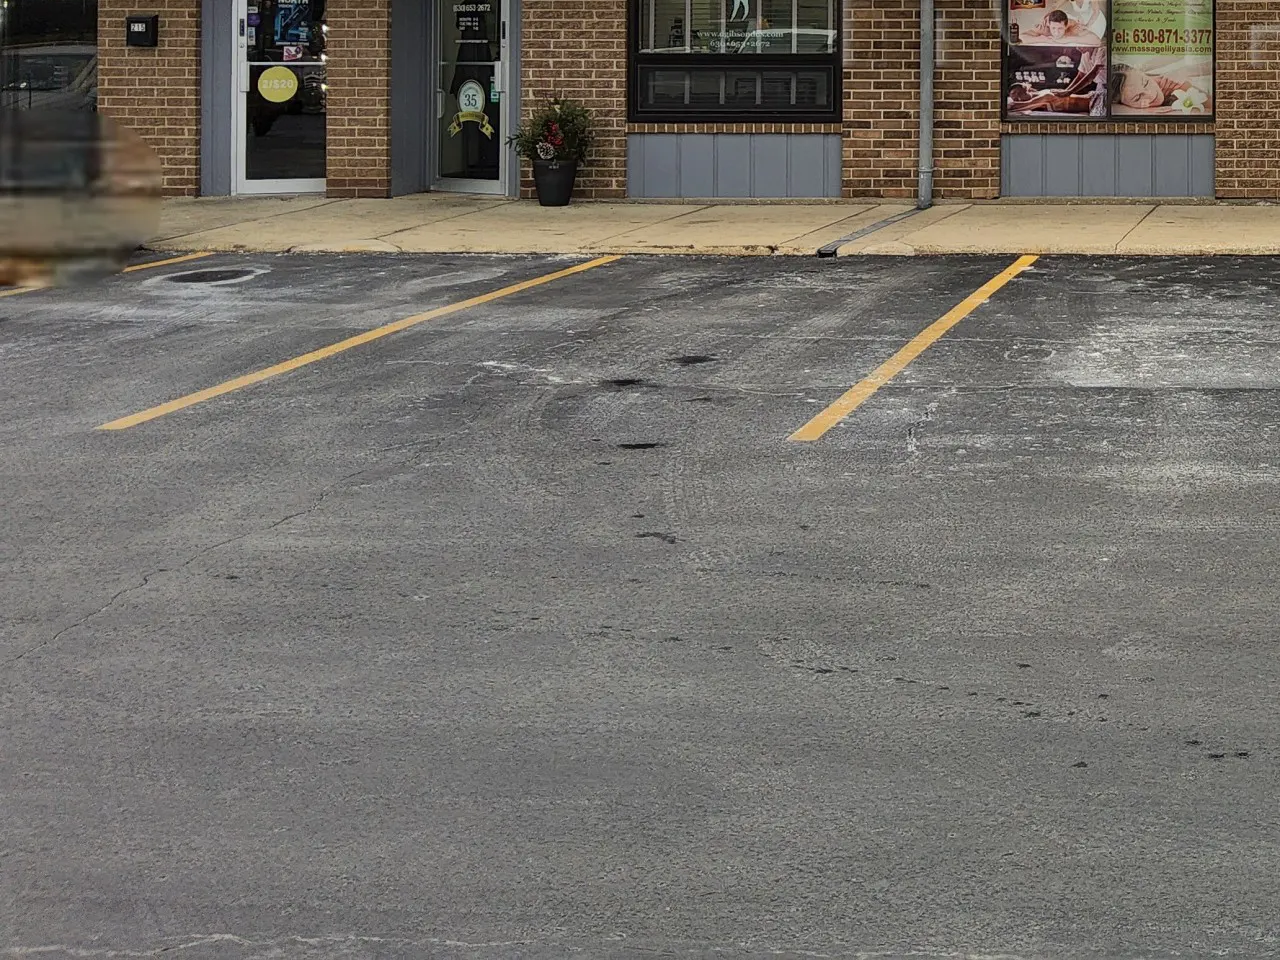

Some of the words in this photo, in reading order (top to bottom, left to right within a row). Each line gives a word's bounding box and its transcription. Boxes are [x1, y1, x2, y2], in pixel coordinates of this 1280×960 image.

[131, 23, 146, 32] 215
[1133, 28, 1212, 44] 630-871-3377
[464, 93, 478, 107] 35
